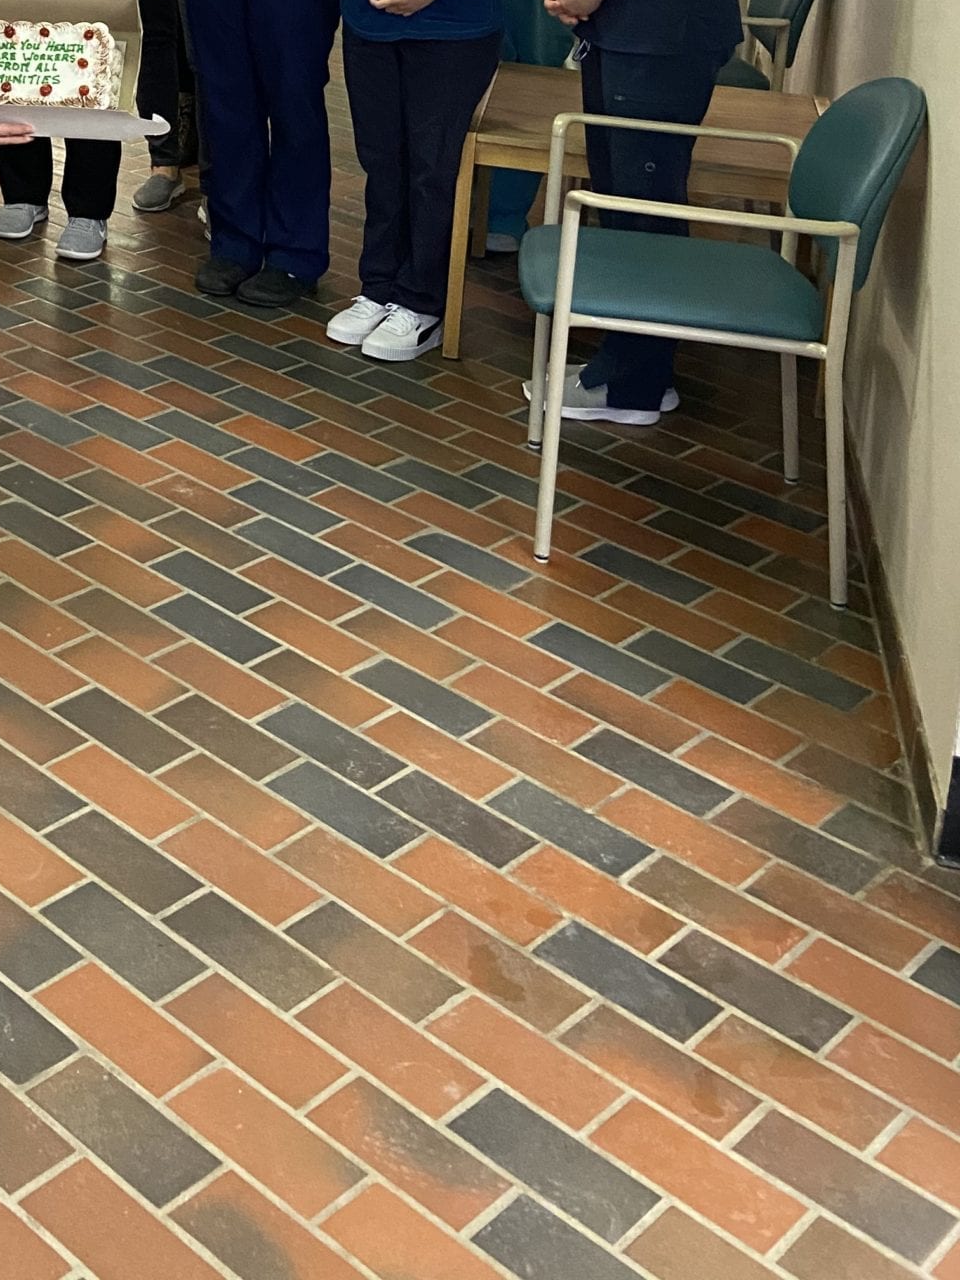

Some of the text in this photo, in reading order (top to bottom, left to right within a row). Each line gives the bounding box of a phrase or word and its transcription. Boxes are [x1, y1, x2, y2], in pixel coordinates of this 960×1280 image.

[20, 39, 40, 51] YOU
[45, 40, 84, 54] HEALTH
[22, 52, 76, 63] WORKERS
[35, 62, 58, 72] ALL
